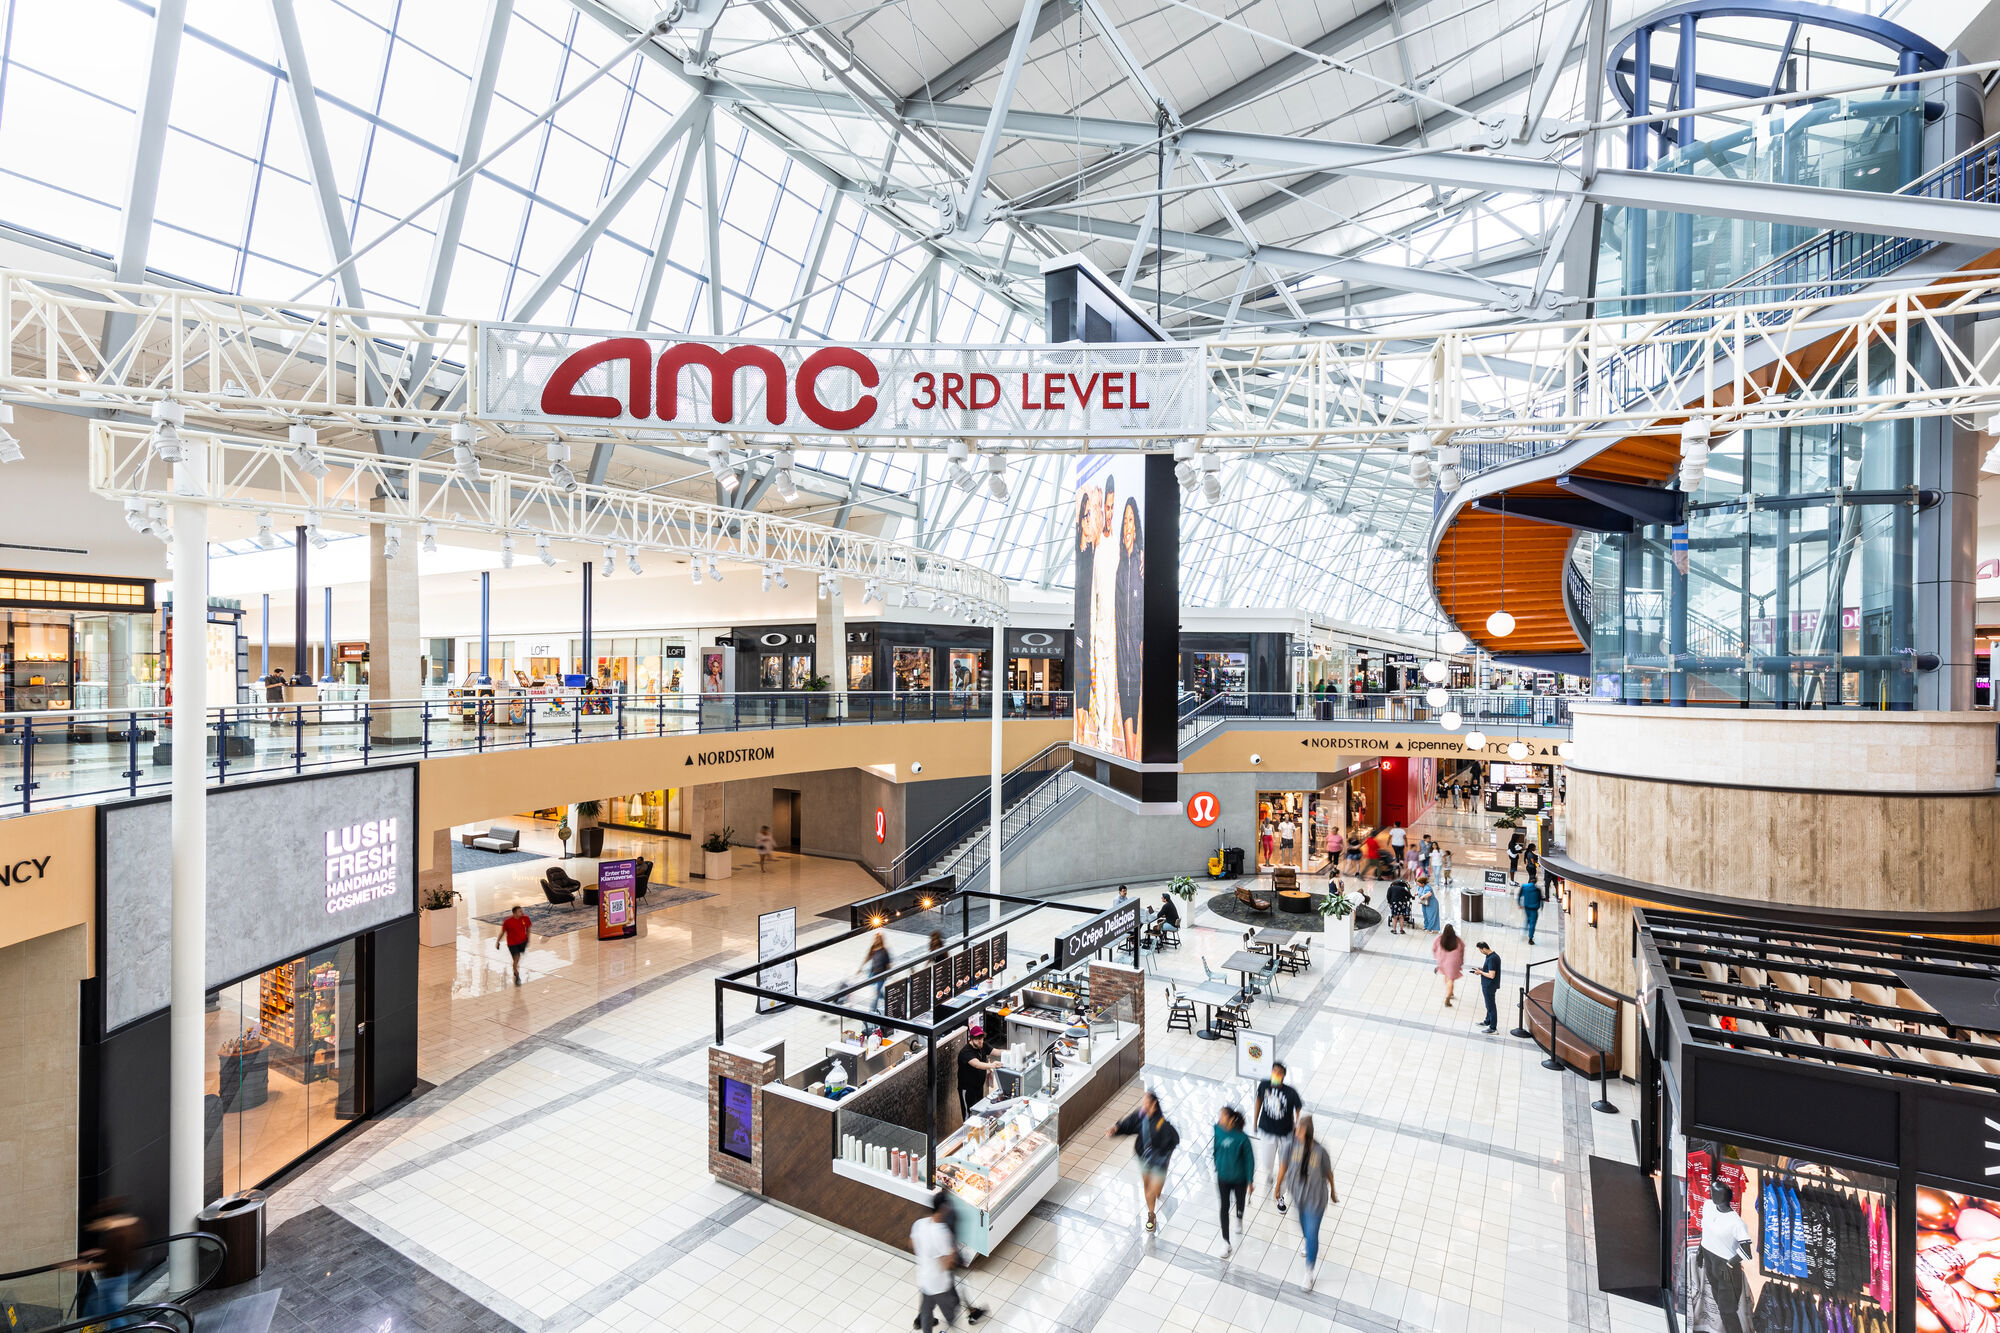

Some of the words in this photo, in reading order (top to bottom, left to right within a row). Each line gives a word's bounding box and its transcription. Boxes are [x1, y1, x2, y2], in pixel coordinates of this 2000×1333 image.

[912, 372, 1001, 411] 3RD
[1022, 372, 1150, 411] LEVEL
[530, 645, 551, 656] LOFT
[667, 648, 685, 656] LOFT
[795, 632, 869, 644] OAEY
[698, 746, 775, 767] NORDSTROM
[1311, 737, 1389, 750] NORDSTROM
[1408, 739, 1464, 754] jcpenney
[325, 818, 397, 857] LUSH
[325, 843, 397, 882] FRESH
[325, 866, 397, 898] HANDMADE
[326, 882, 397, 914] COSMETICS
[1081, 926, 1104, 948] Crêpe
[1104, 909, 1135, 935] Delicious
